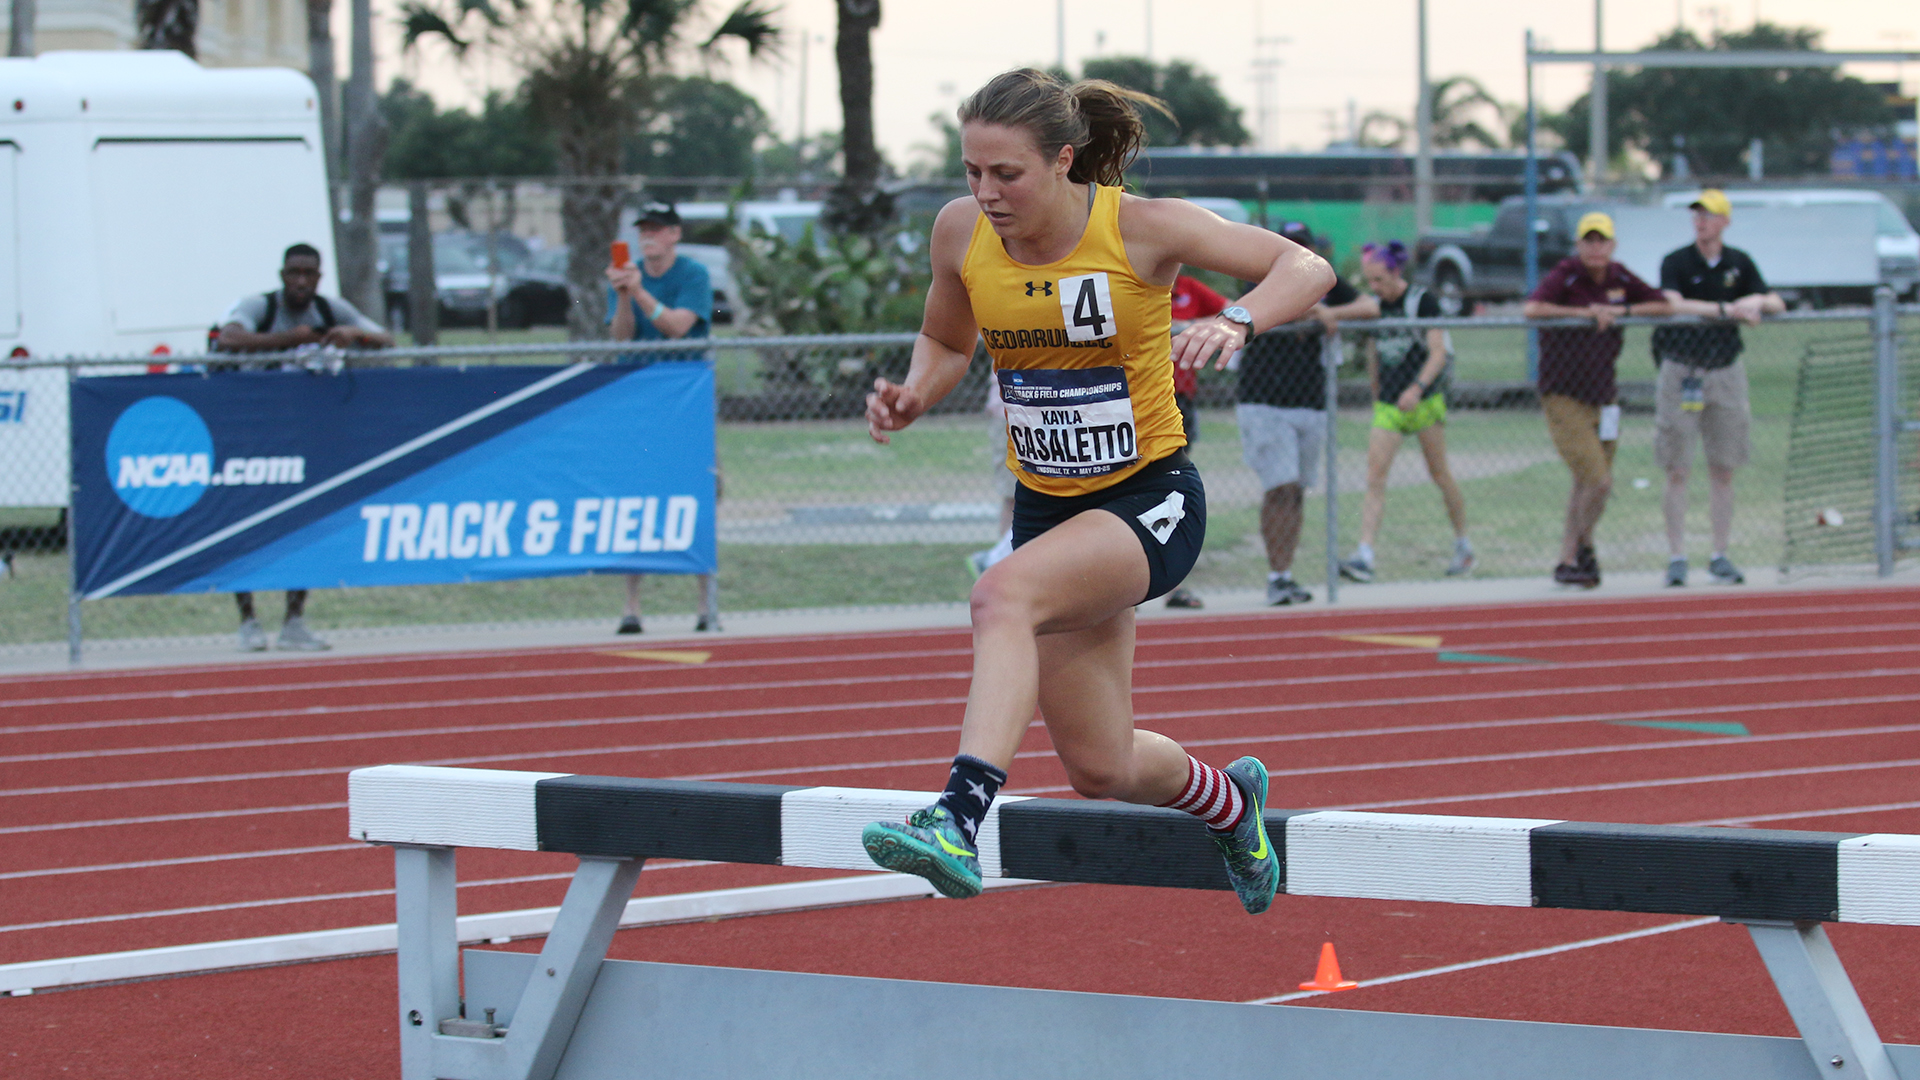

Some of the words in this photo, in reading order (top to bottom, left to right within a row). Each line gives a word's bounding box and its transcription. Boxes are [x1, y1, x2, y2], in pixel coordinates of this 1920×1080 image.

[1073, 278, 1107, 336] 4
[982, 327, 1113, 350] CEDARVIE
[1034, 391, 1039, 399] &
[1040, 390, 1058, 399] FIELD
[1059, 382, 1123, 398] CHAMPIONSHIPS
[1041, 410, 1082, 425] KAYLA
[1011, 421, 1134, 463] CASALETTO
[116, 453, 305, 489] NCAA.com
[1079, 467, 1092, 475] MAY
[360, 501, 517, 563] TRACK
[522, 499, 560, 556] &
[569, 495, 699, 554] FIELD
